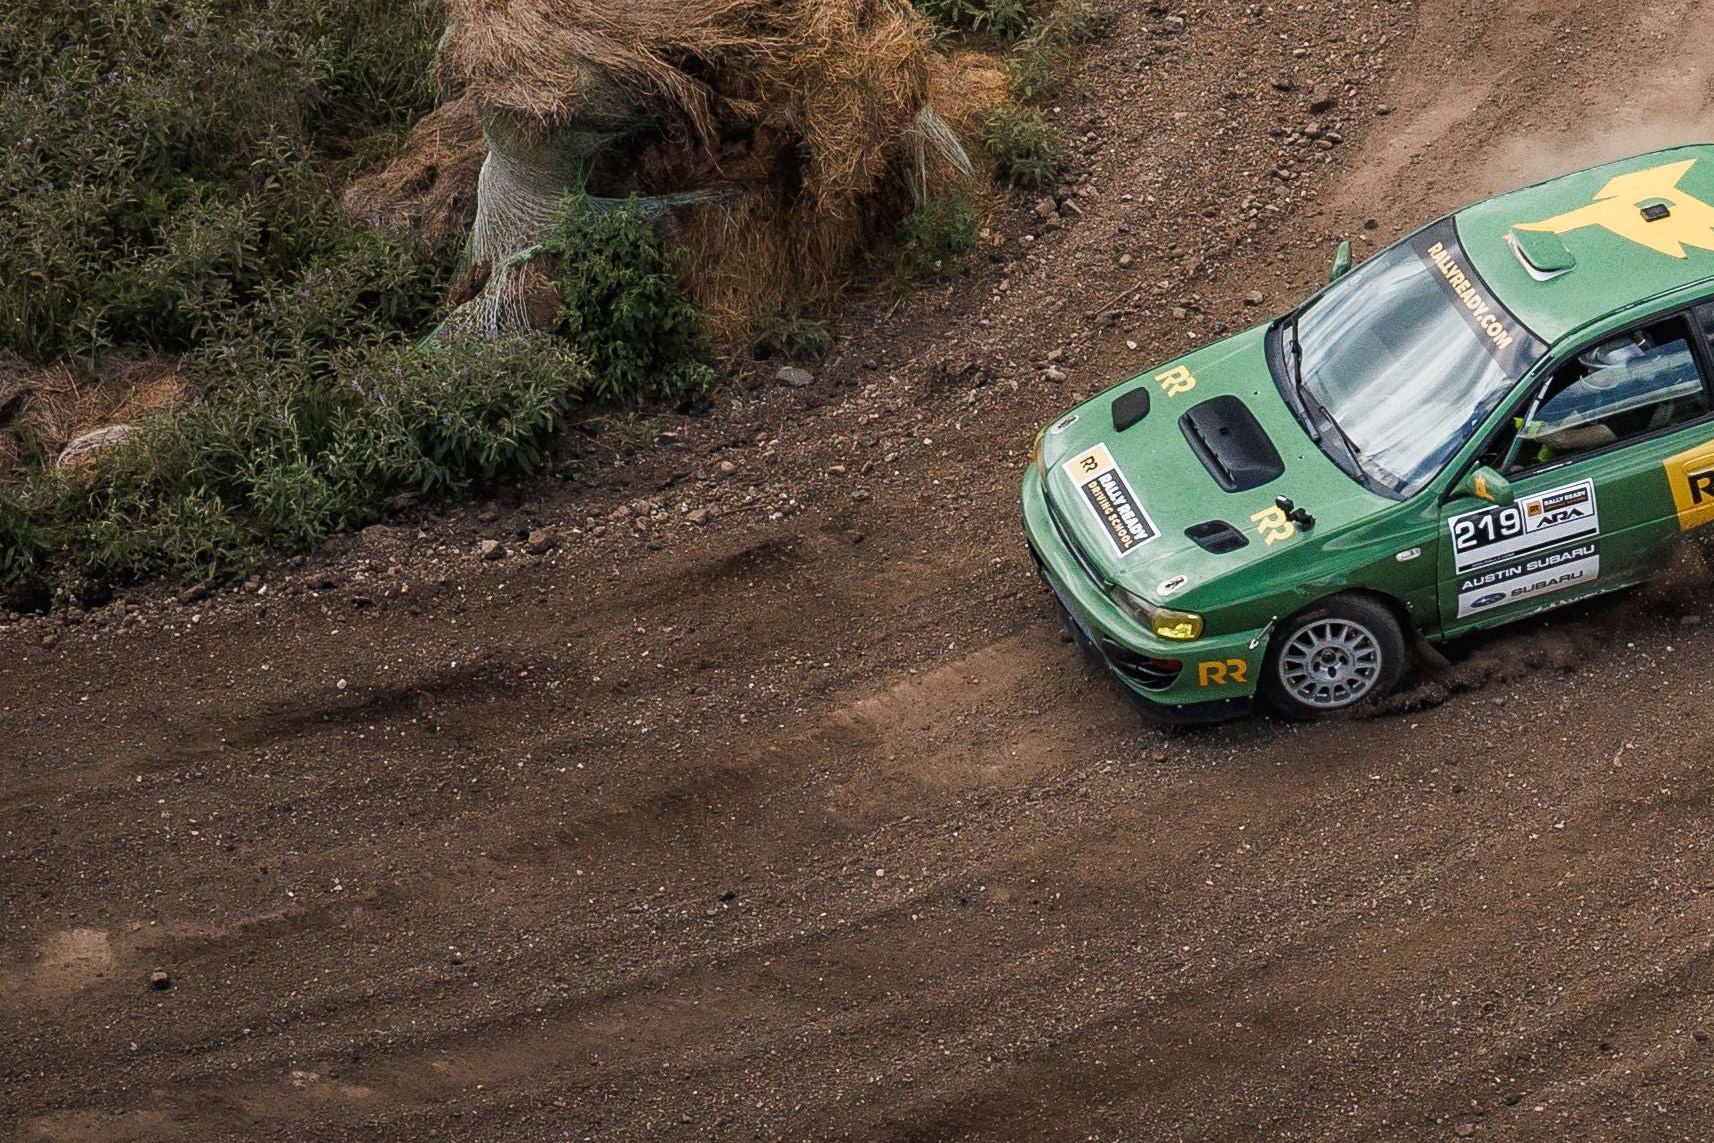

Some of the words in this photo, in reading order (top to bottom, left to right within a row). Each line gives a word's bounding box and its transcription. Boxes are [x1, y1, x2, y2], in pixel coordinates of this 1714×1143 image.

[1427, 241, 1513, 350] RALLYREADY.COM
[1154, 364, 1197, 398] RR
[1087, 480, 1114, 515] DRIVING
[1108, 513, 1134, 549] SCHOOL
[1098, 472, 1127, 506] RALLY
[1116, 503, 1149, 540] READY
[1536, 508, 1584, 528] ARA
[1455, 508, 1521, 549] 219
[1461, 565, 1522, 591] AUSTIN
[1526, 544, 1595, 571] SUBARU
[1510, 570, 1584, 597] SUBARU
[1199, 659, 1248, 687] RR
